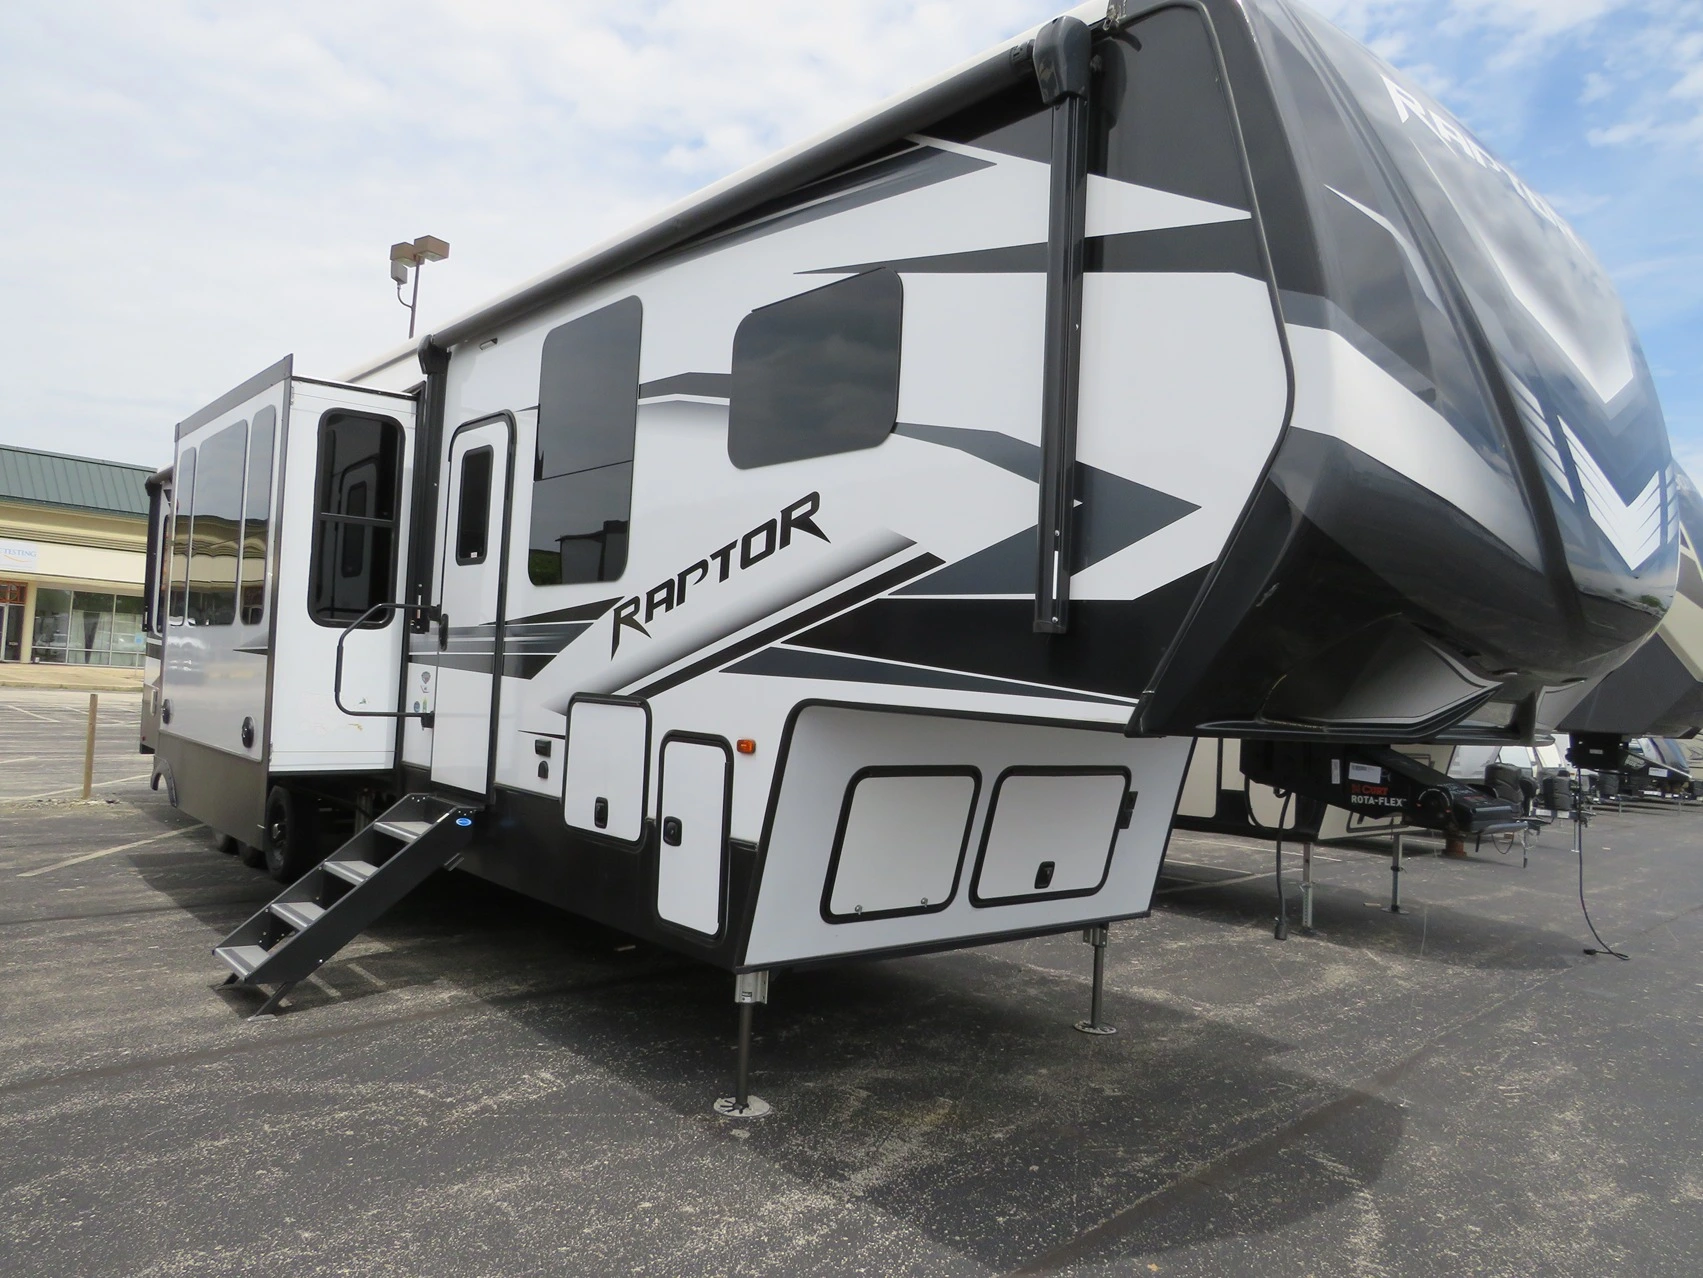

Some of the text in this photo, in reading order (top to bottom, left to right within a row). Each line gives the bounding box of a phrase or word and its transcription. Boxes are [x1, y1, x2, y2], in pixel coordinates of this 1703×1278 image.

[4, 548, 37, 557] TESTING
[611, 491, 831, 661] RAPTOR
[1351, 794, 1403, 807] ROTA-FLEX
